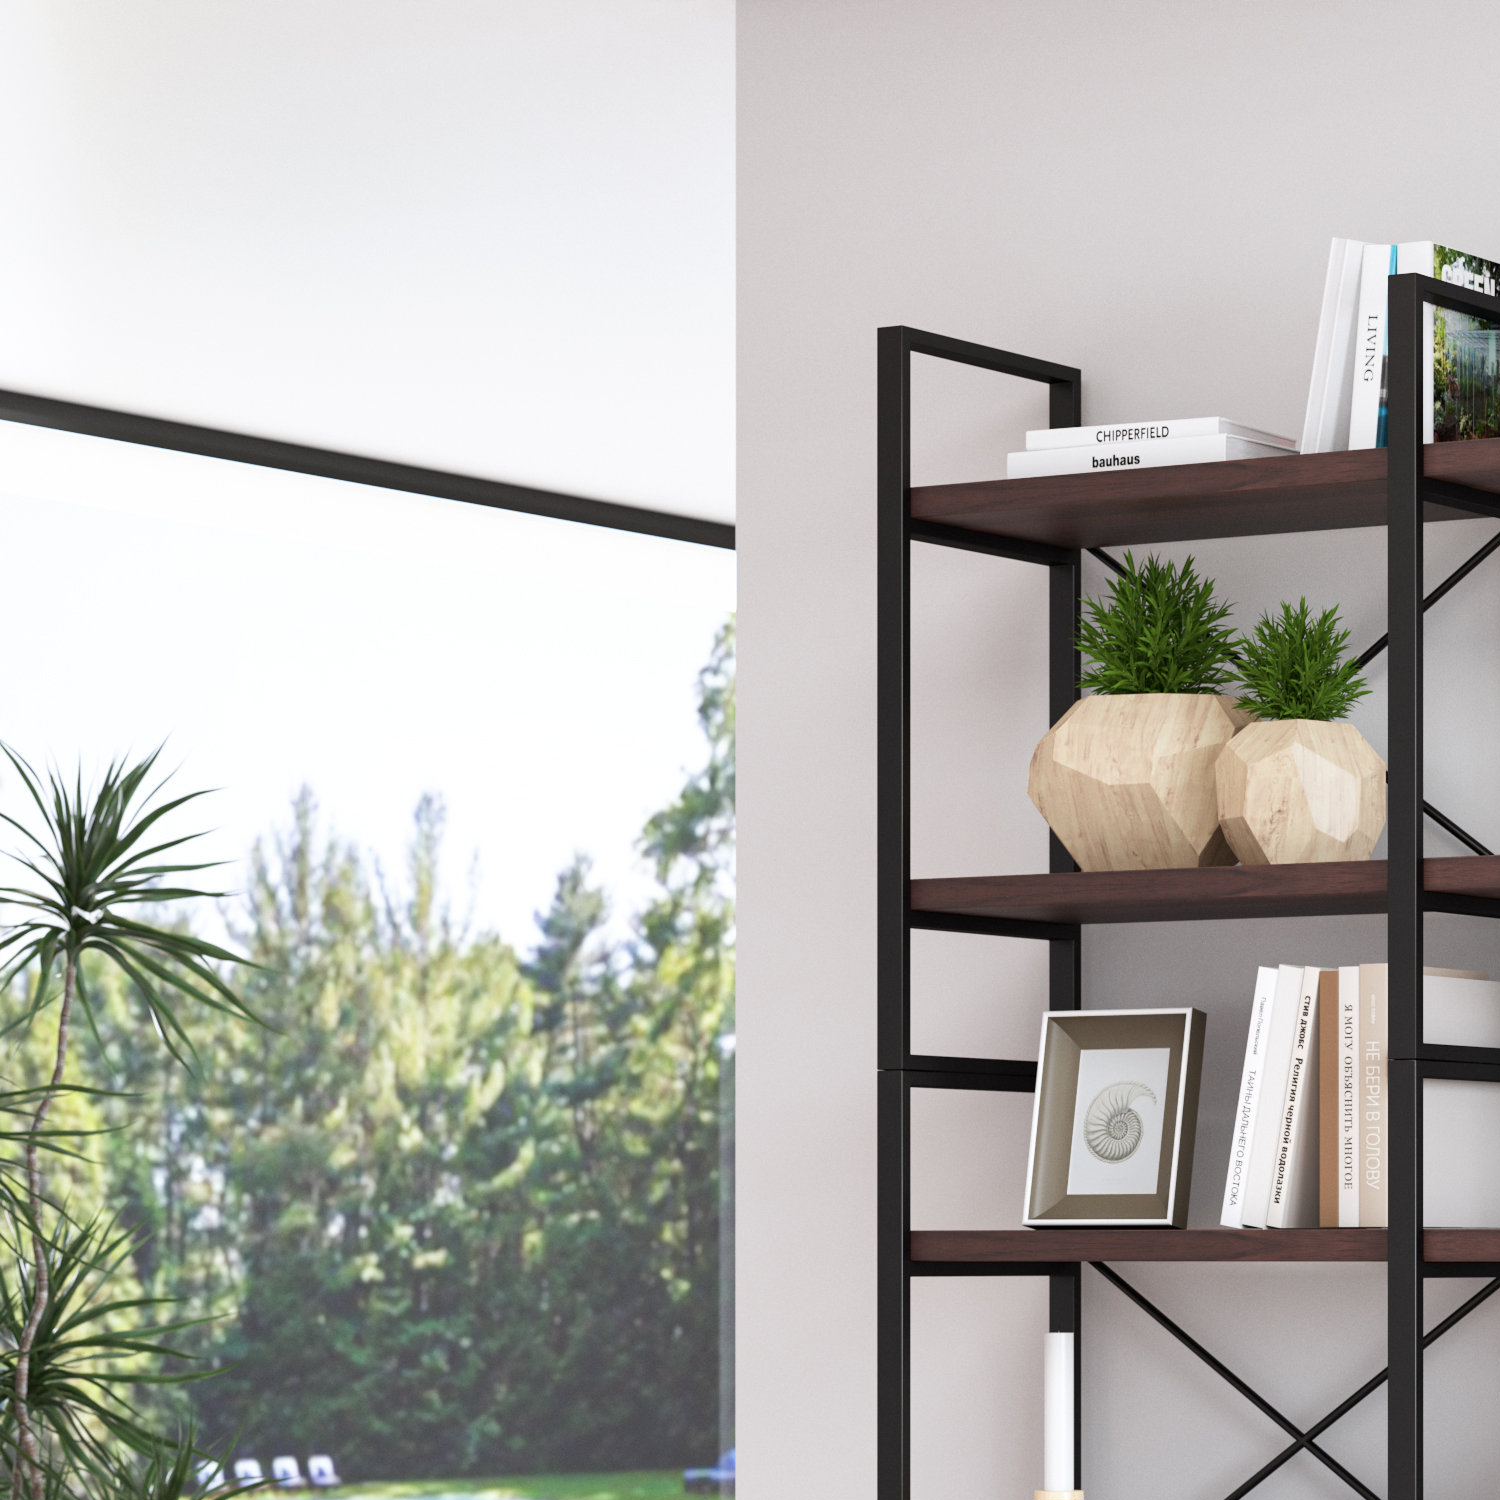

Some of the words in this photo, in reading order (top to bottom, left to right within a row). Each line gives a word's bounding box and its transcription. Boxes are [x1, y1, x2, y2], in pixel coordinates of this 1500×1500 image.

[1362, 314, 1378, 383] LIVING
[1095, 426, 1169, 444] CHIPPERFIELD
[1092, 452, 1141, 469] bauhaus
[1344, 1004, 1353, 1016] Я
[1344, 1016, 1353, 1050] МОГУ
[1366, 1041, 1380, 1060] НЕ
[1291, 1058, 1304, 1103] Религия
[1344, 1056, 1353, 1132] ОБЪЯСНИТЬ
[1366, 1066, 1380, 1106] БЕРИ
[1237, 1105, 1250, 1158] ДАЛЬНЕГО
[1283, 1105, 1294, 1143] черной
[1366, 1111, 1380, 1120] В
[1274, 1147, 1287, 1204] водолазки
[1344, 1137, 1353, 1190] МНОГОЕ
[1366, 1126, 1380, 1190] ГОЛОВУ
[1229, 1160, 1243, 1206] ВОСТОКА
